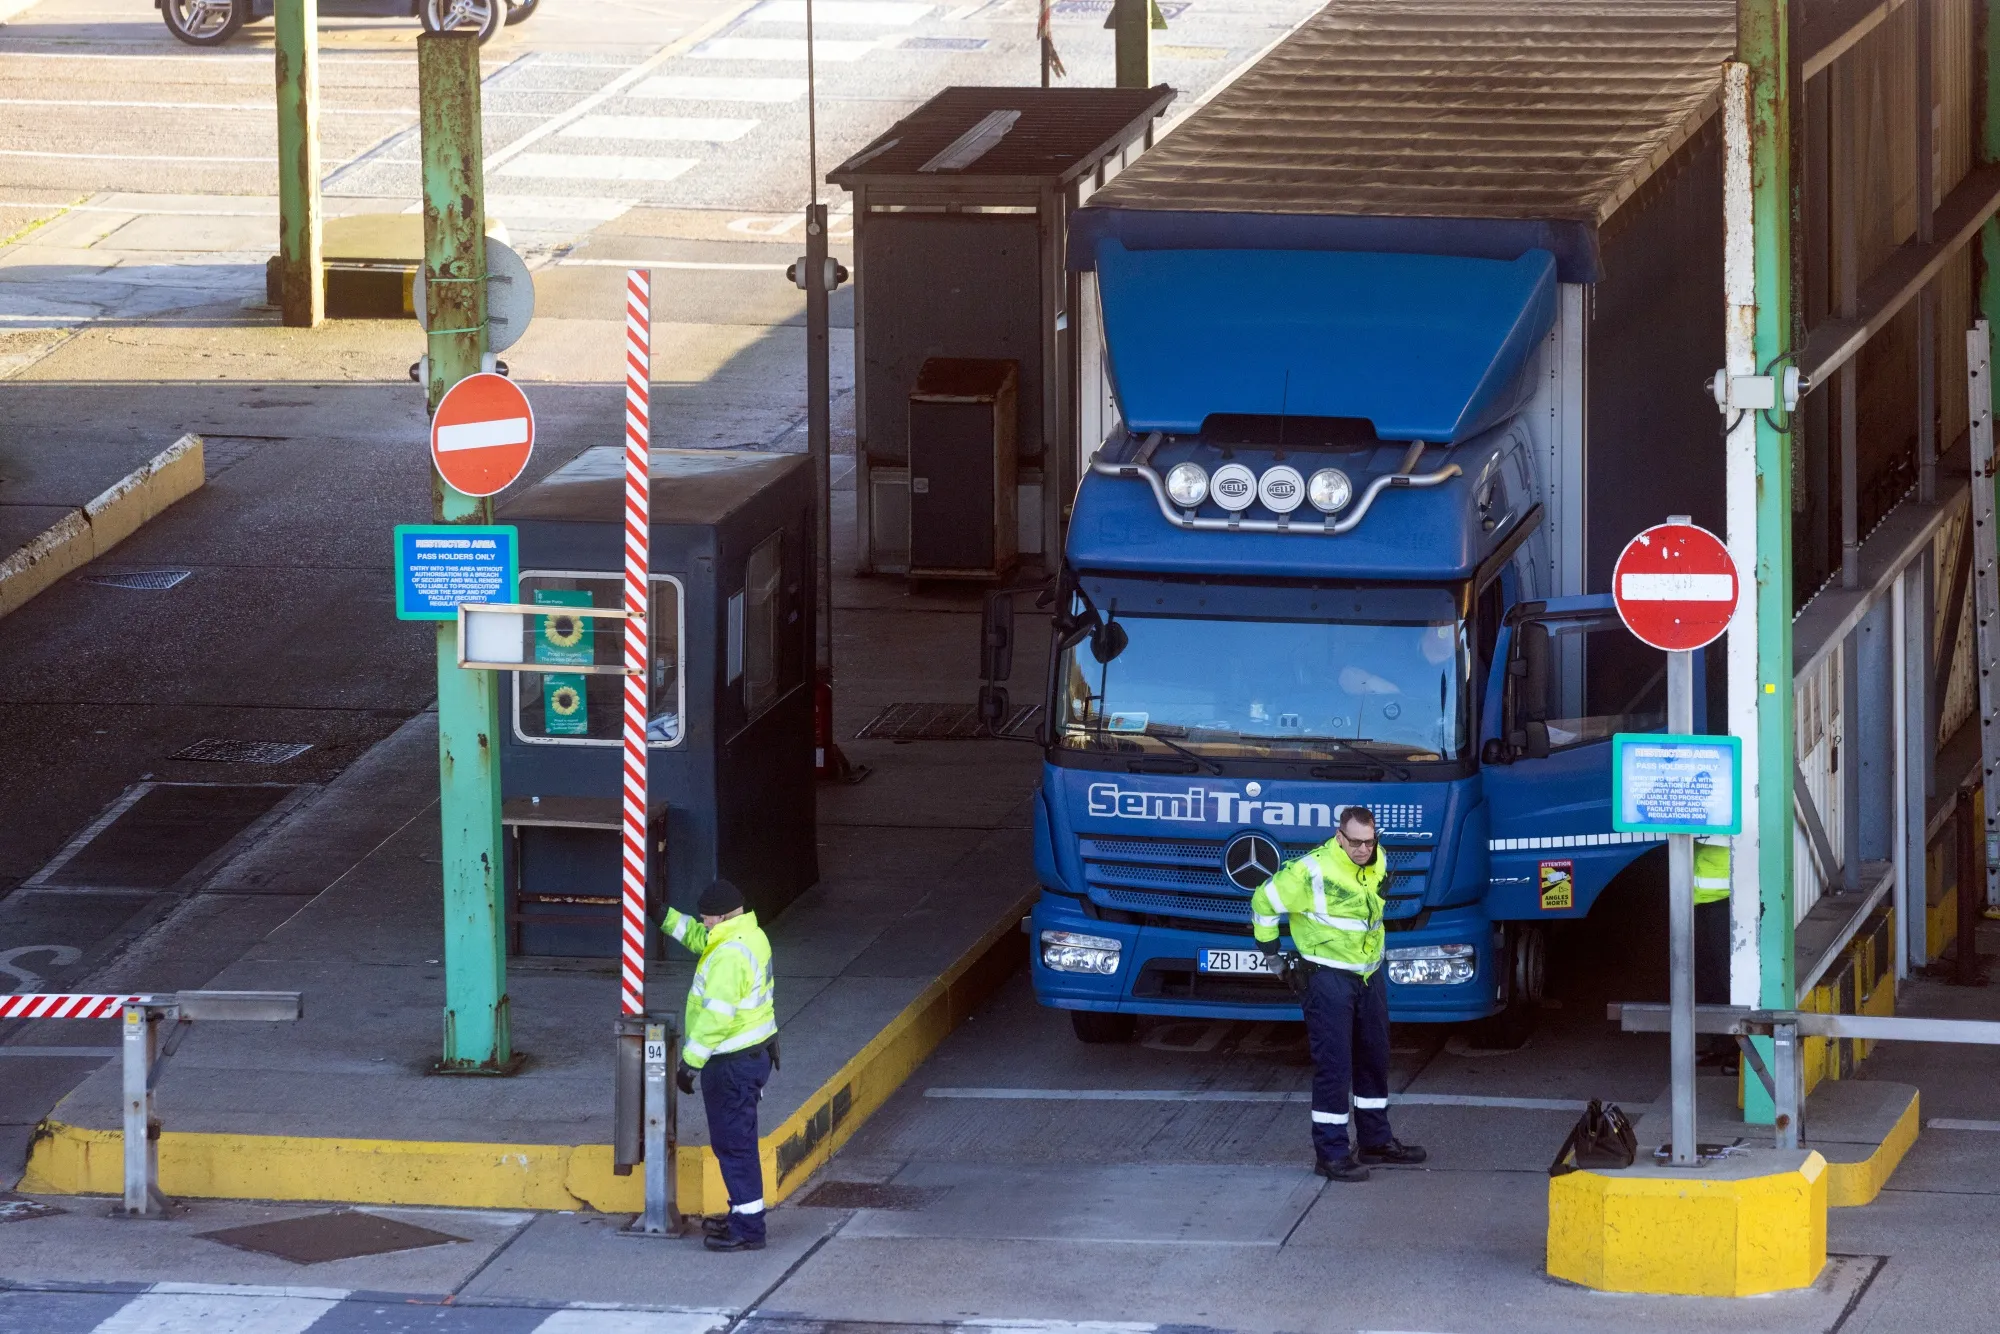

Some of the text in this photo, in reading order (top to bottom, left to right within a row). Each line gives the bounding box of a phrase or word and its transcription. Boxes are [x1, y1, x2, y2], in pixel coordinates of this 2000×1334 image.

[1221, 483, 1248, 492] HELLA
[1269, 485, 1296, 493] HELLA
[415, 539, 497, 548] RESTRICTED AREA
[1635, 748, 1720, 758] RESTRICTED AREA
[1636, 762, 1656, 770] PASS
[1209, 952, 1239, 970] ZBI
[648, 1045, 662, 1059] 94
